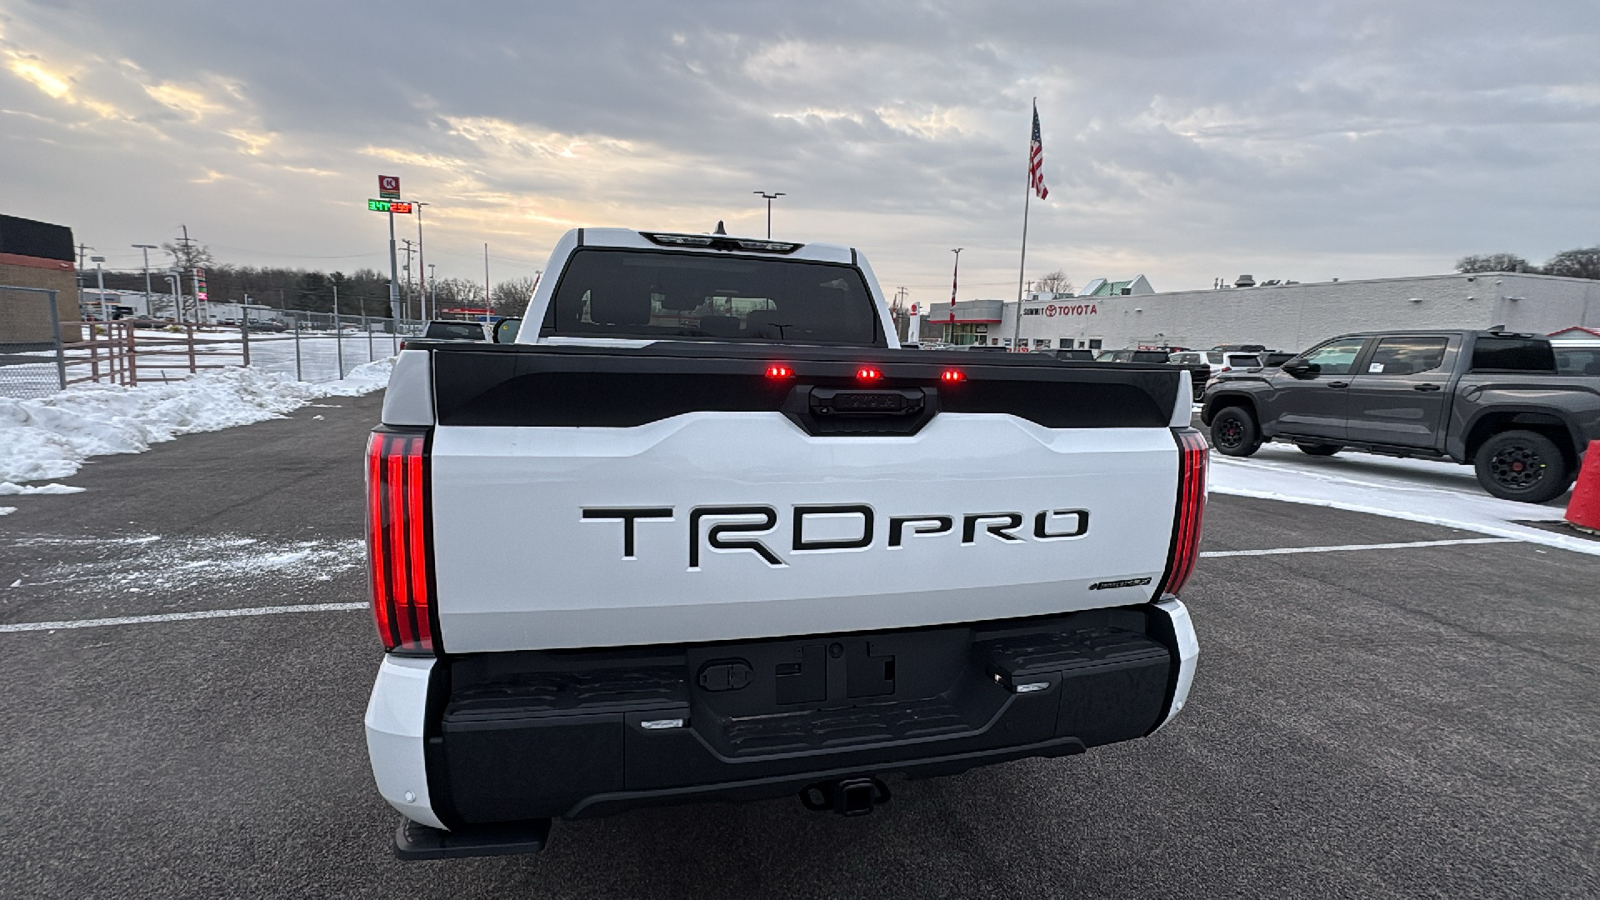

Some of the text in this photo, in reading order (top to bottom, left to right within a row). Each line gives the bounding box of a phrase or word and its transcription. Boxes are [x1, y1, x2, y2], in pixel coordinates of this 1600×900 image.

[1023, 304, 1098, 316] SUMMIT TOYOTA
[580, 503, 1091, 572] TRD PRO
